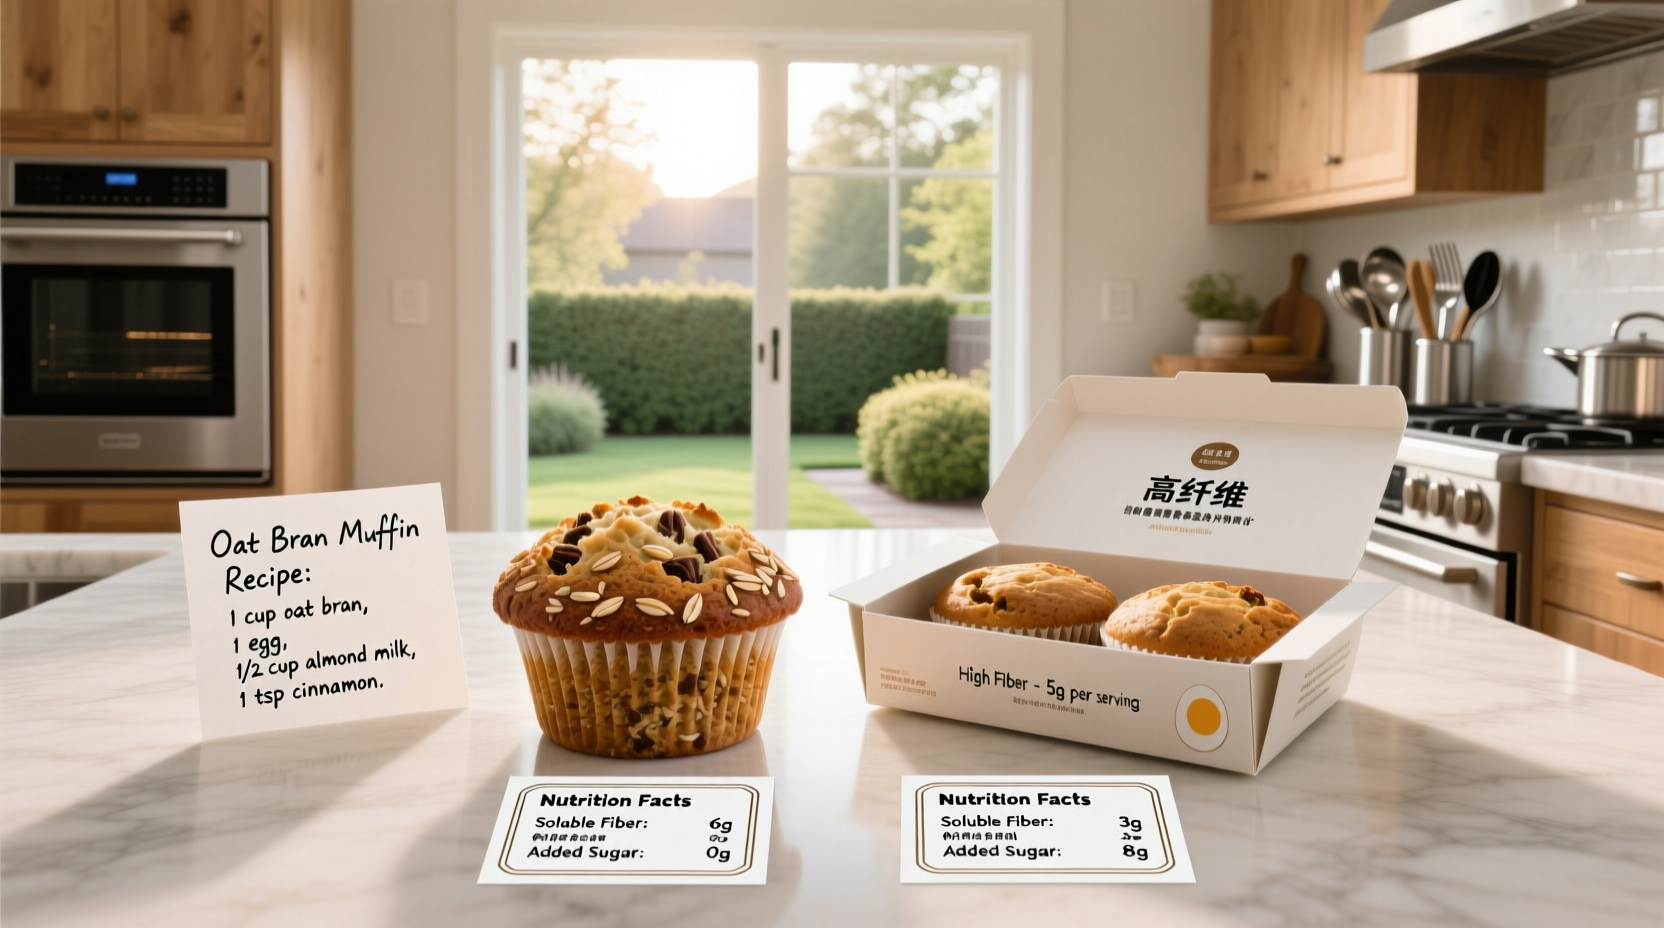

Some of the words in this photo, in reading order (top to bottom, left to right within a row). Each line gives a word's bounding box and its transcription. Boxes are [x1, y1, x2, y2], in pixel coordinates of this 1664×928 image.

[1142, 474, 1249, 509] 高纤维
[210, 529, 261, 559] Oat
[271, 524, 328, 554] Bran
[338, 512, 420, 551] Muffin
[225, 565, 311, 597] Recipe:
[230, 609, 236, 627] 1
[244, 609, 277, 630] cup
[284, 599, 315, 620] oat
[321, 595, 368, 616] bran,
[233, 637, 239, 654] 1
[248, 635, 288, 659] egg,
[236, 658, 264, 684] 1/2
[268, 660, 299, 680] cup
[305, 643, 367, 670] almond
[374, 638, 416, 662] milk,
[239, 691, 246, 709] 1
[253, 688, 285, 710] tsp
[292, 676, 384, 700] cinnamon.
[959, 665, 991, 688] High
[1046, 678, 1065, 702] 5g
[1070, 688, 1093, 705] per
[1096, 692, 1140, 713] serving
[539, 793, 632, 808] Nutrition
[638, 793, 692, 808] Facts
[939, 792, 1031, 806] Nutrition
[1037, 792, 1092, 806] Facts
[600, 815, 648, 829] Fiber:
[709, 817, 733, 834] 6g
[940, 814, 1002, 828] Soluble
[1006, 814, 1054, 828] Fiber:
[1118, 815, 1143, 833] 3g
[526, 845, 584, 858] Added
[588, 846, 644, 862] Sugar:
[706, 845, 731, 863] 0g
[943, 844, 1000, 858] Added
[1005, 845, 1062, 861] Sugar:
[1122, 844, 1149, 862] 8g
